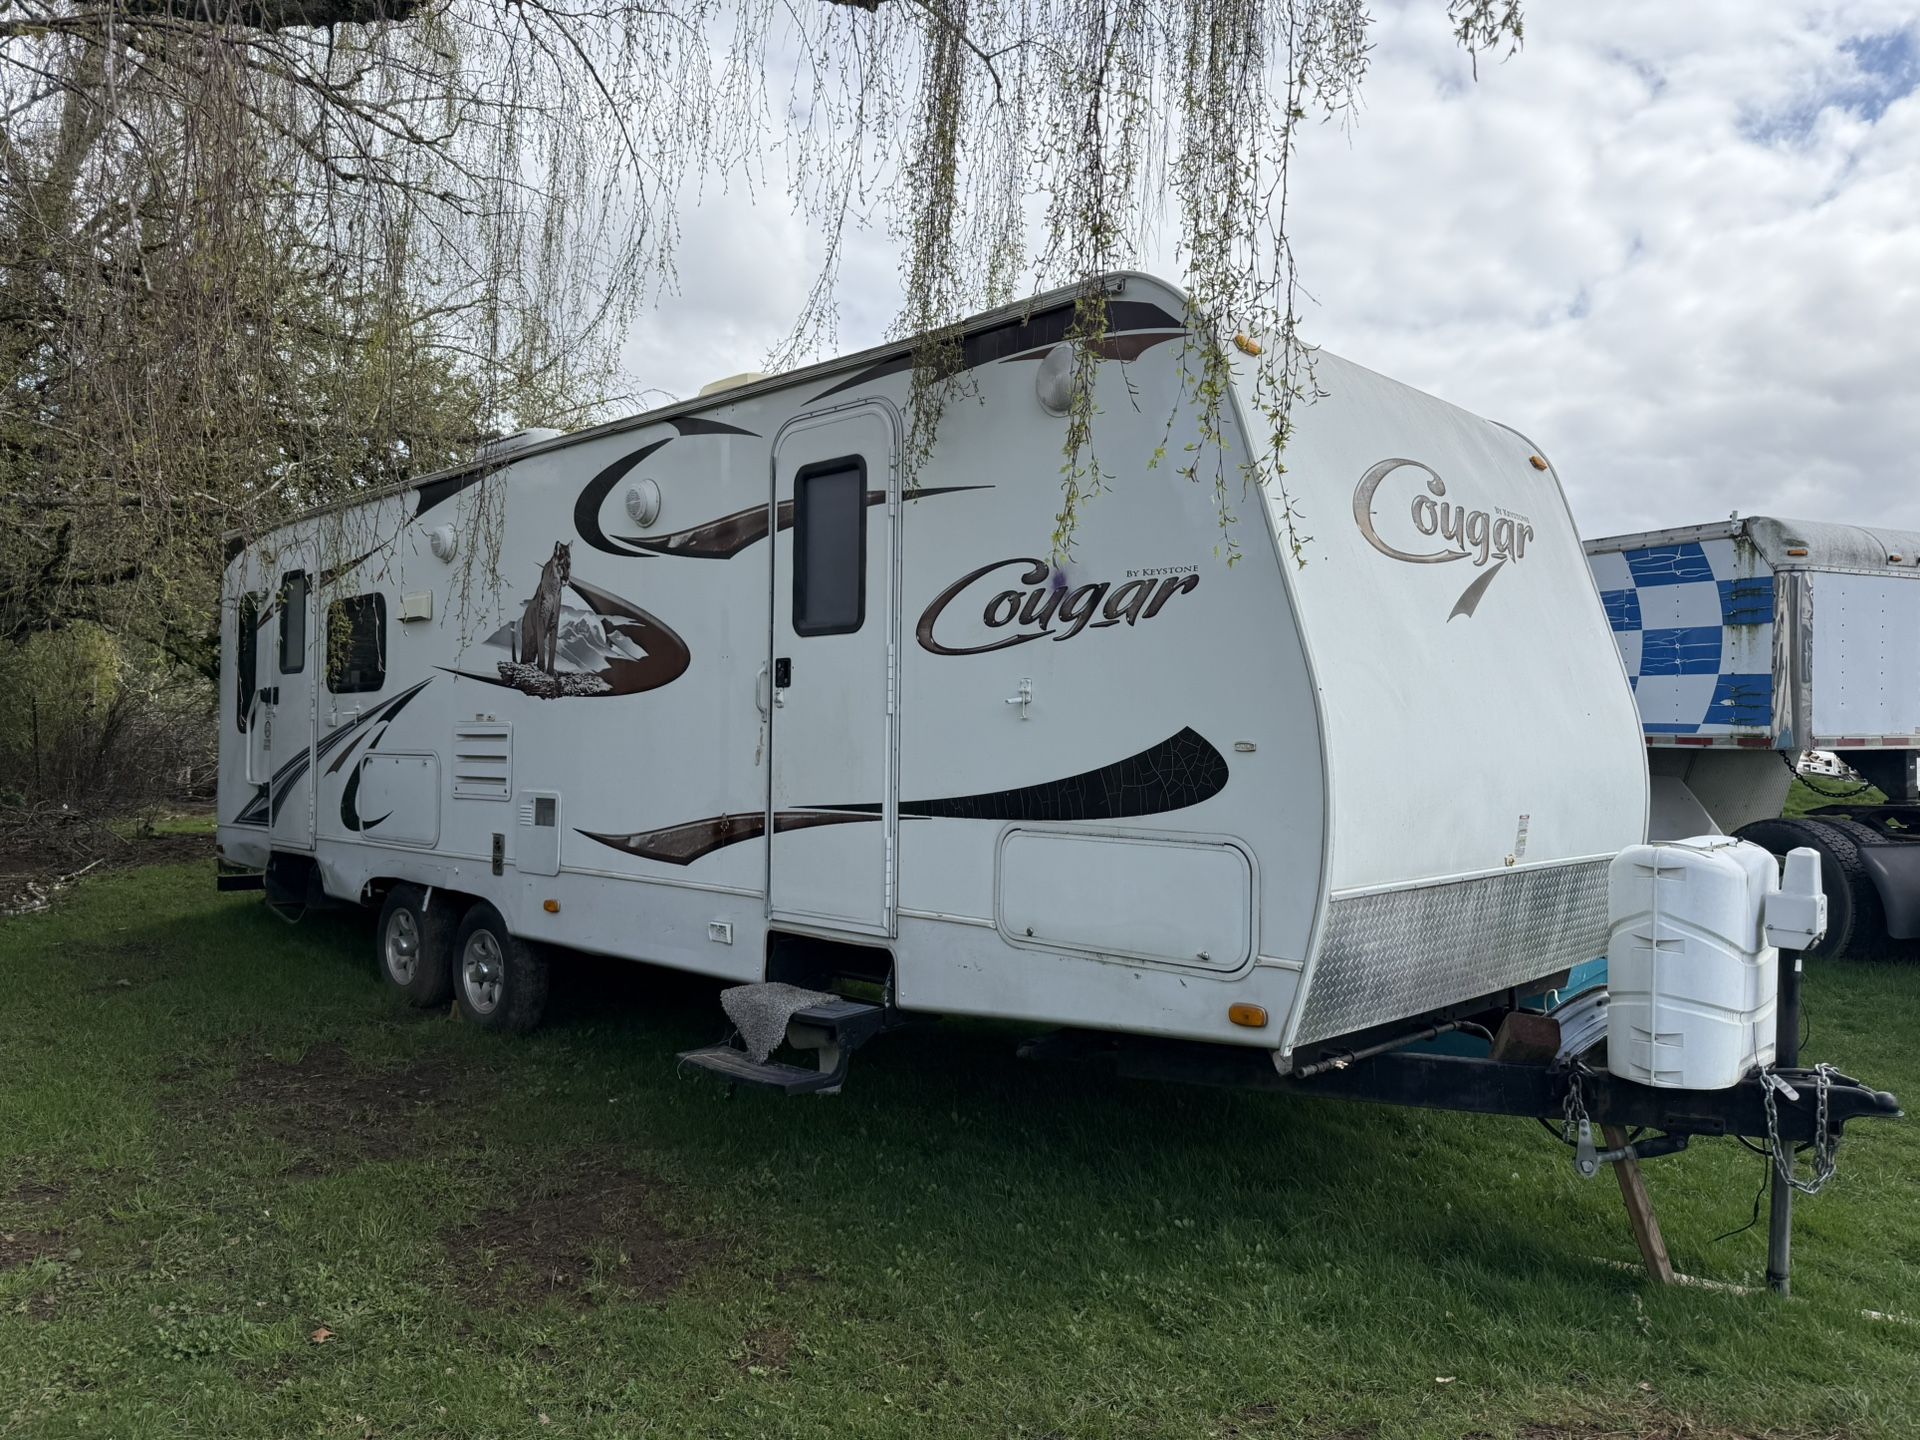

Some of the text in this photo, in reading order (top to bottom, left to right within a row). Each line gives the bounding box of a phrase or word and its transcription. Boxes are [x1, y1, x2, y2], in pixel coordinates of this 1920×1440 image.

[1352, 458, 1534, 567] Cougar
[916, 557, 1200, 656] Cougar
[1126, 565, 1199, 578] BY KEYSTONE
